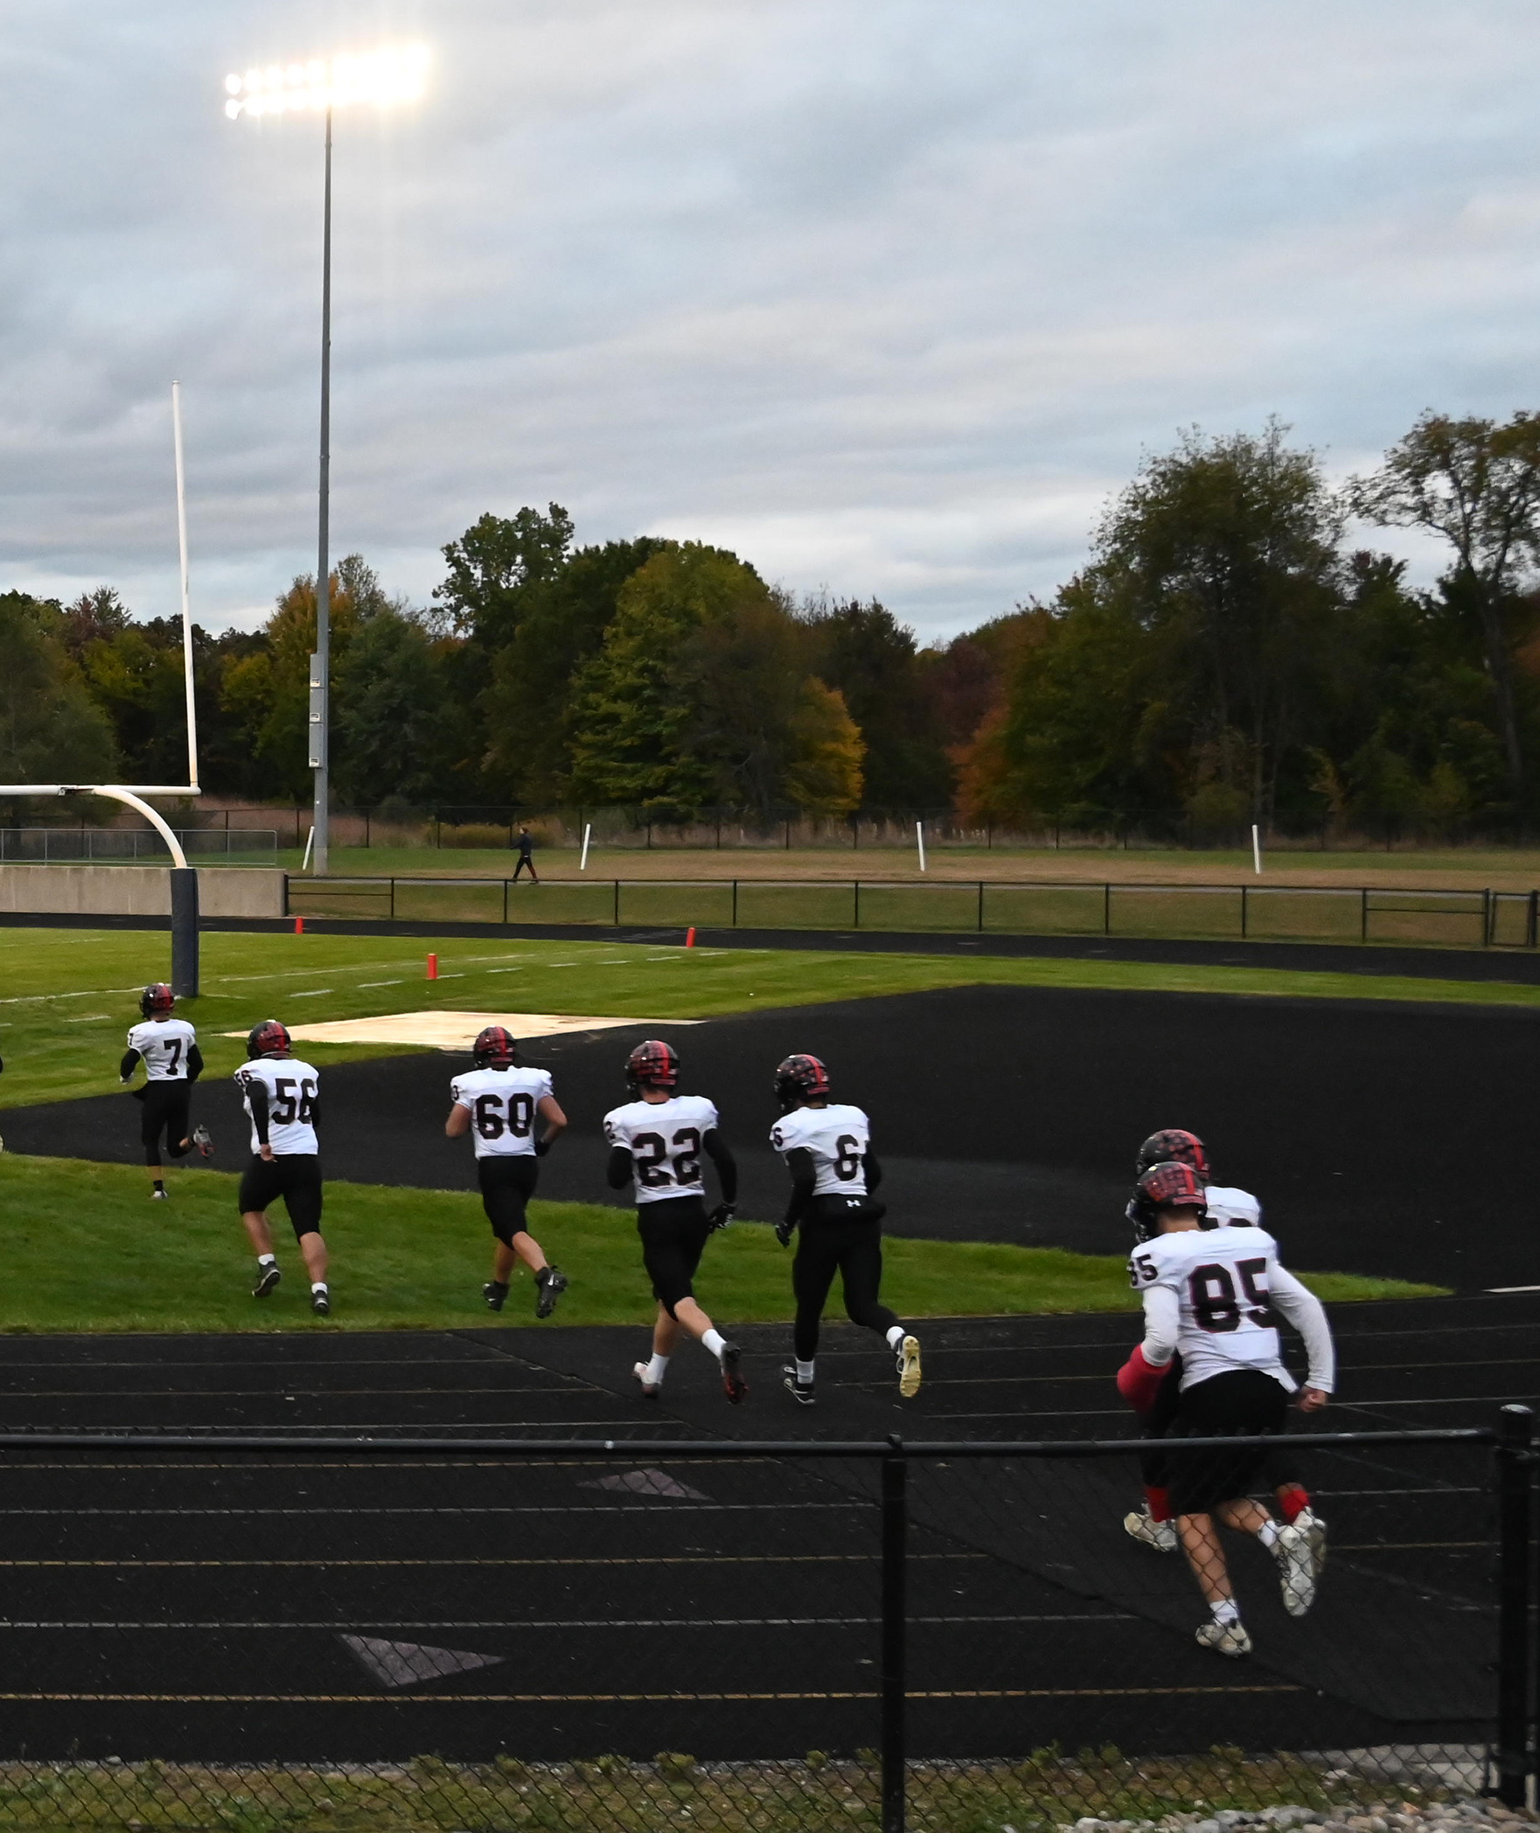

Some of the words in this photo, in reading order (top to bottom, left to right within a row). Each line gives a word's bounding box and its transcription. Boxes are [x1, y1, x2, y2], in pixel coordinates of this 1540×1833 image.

[164, 1038, 182, 1076] 7
[271, 1078, 316, 1125] 56
[476, 1092, 533, 1140] 60
[632, 1127, 702, 1187] 22
[833, 1134, 859, 1182] 6
[1188, 1257, 1275, 1334] 85
